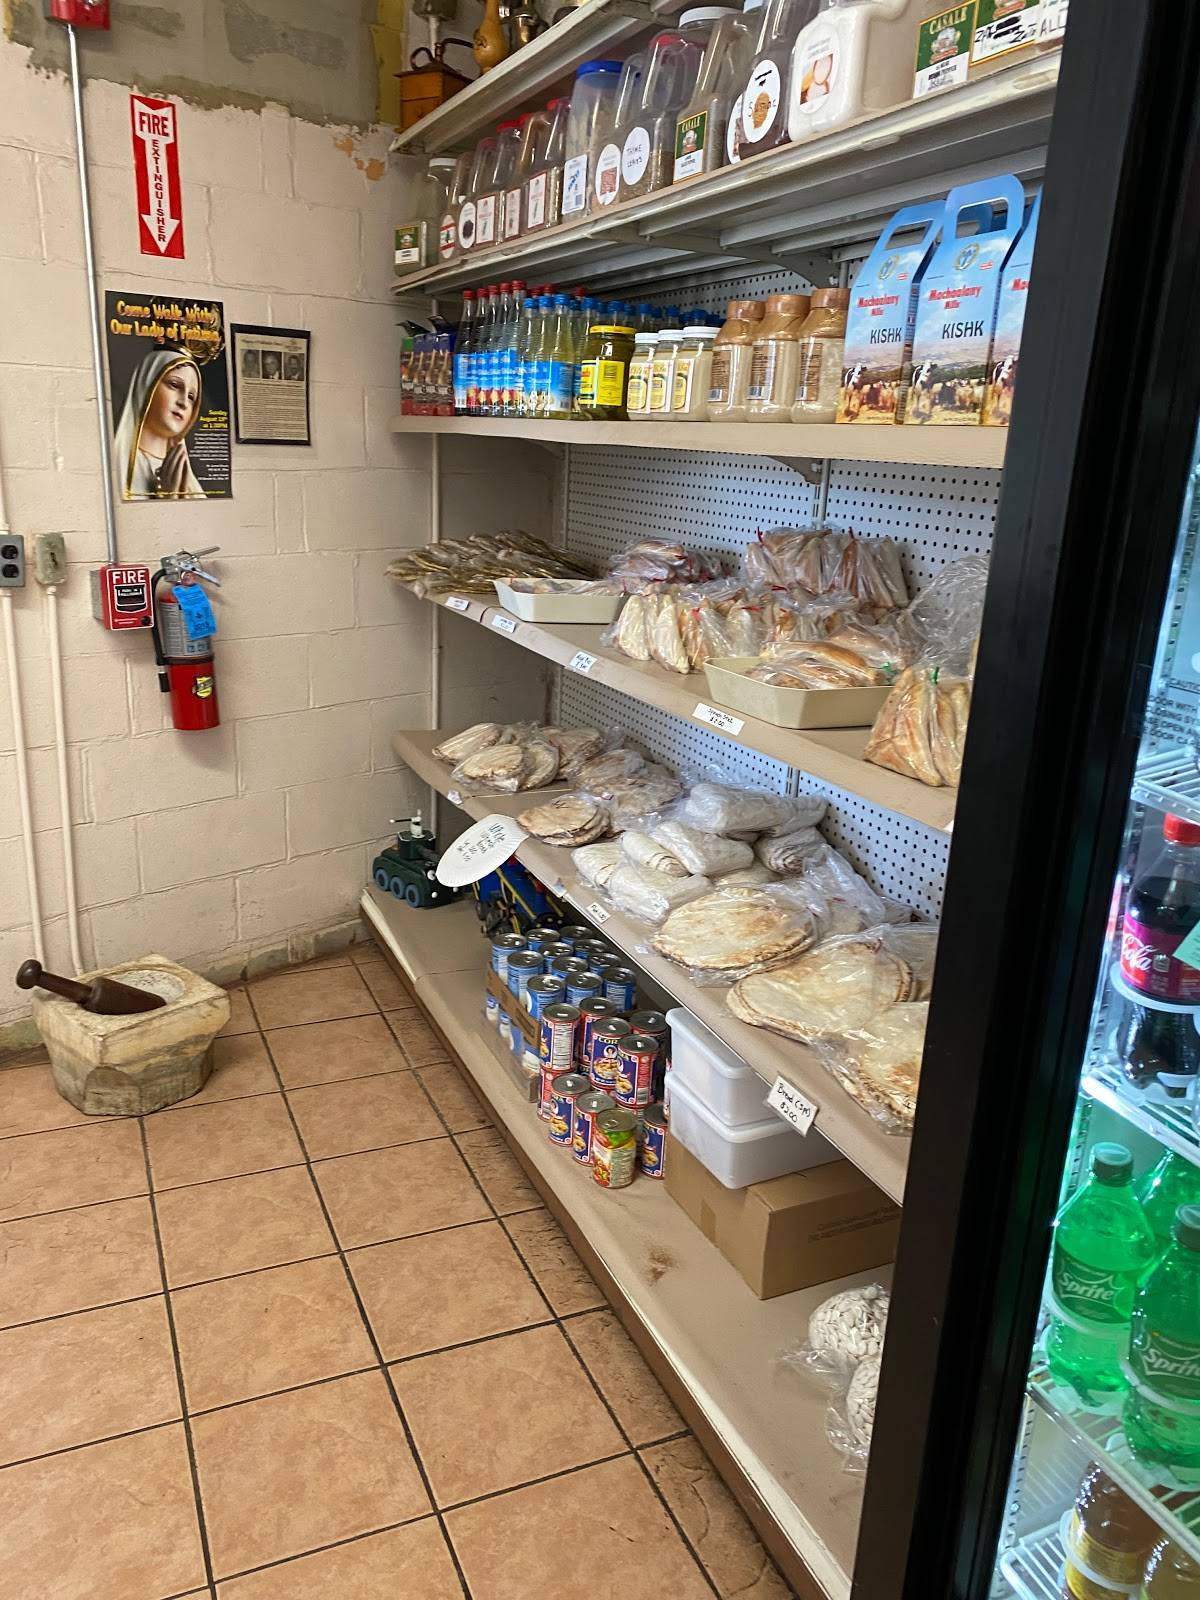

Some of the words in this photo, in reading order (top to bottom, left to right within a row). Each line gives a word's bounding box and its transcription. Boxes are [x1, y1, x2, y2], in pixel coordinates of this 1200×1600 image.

[929, 7, 968, 35] CASALE
[138, 111, 170, 137] FIRE
[682, 116, 701, 133] CASALE
[151, 139, 167, 243] EXTINGUISHER
[116, 300, 150, 317] Come
[152, 303, 183, 321] Walk
[185, 303, 211, 323] With
[110, 318, 133, 335] Our
[134, 321, 165, 345] Lady
[166, 322, 179, 341] of
[180, 325, 221, 343] Fatima
[870, 328, 902, 344] KISHK
[942, 320, 985, 339] KISHK
[112, 570, 146, 584] FIRE
[1059, 1270, 1115, 1301] Sprite
